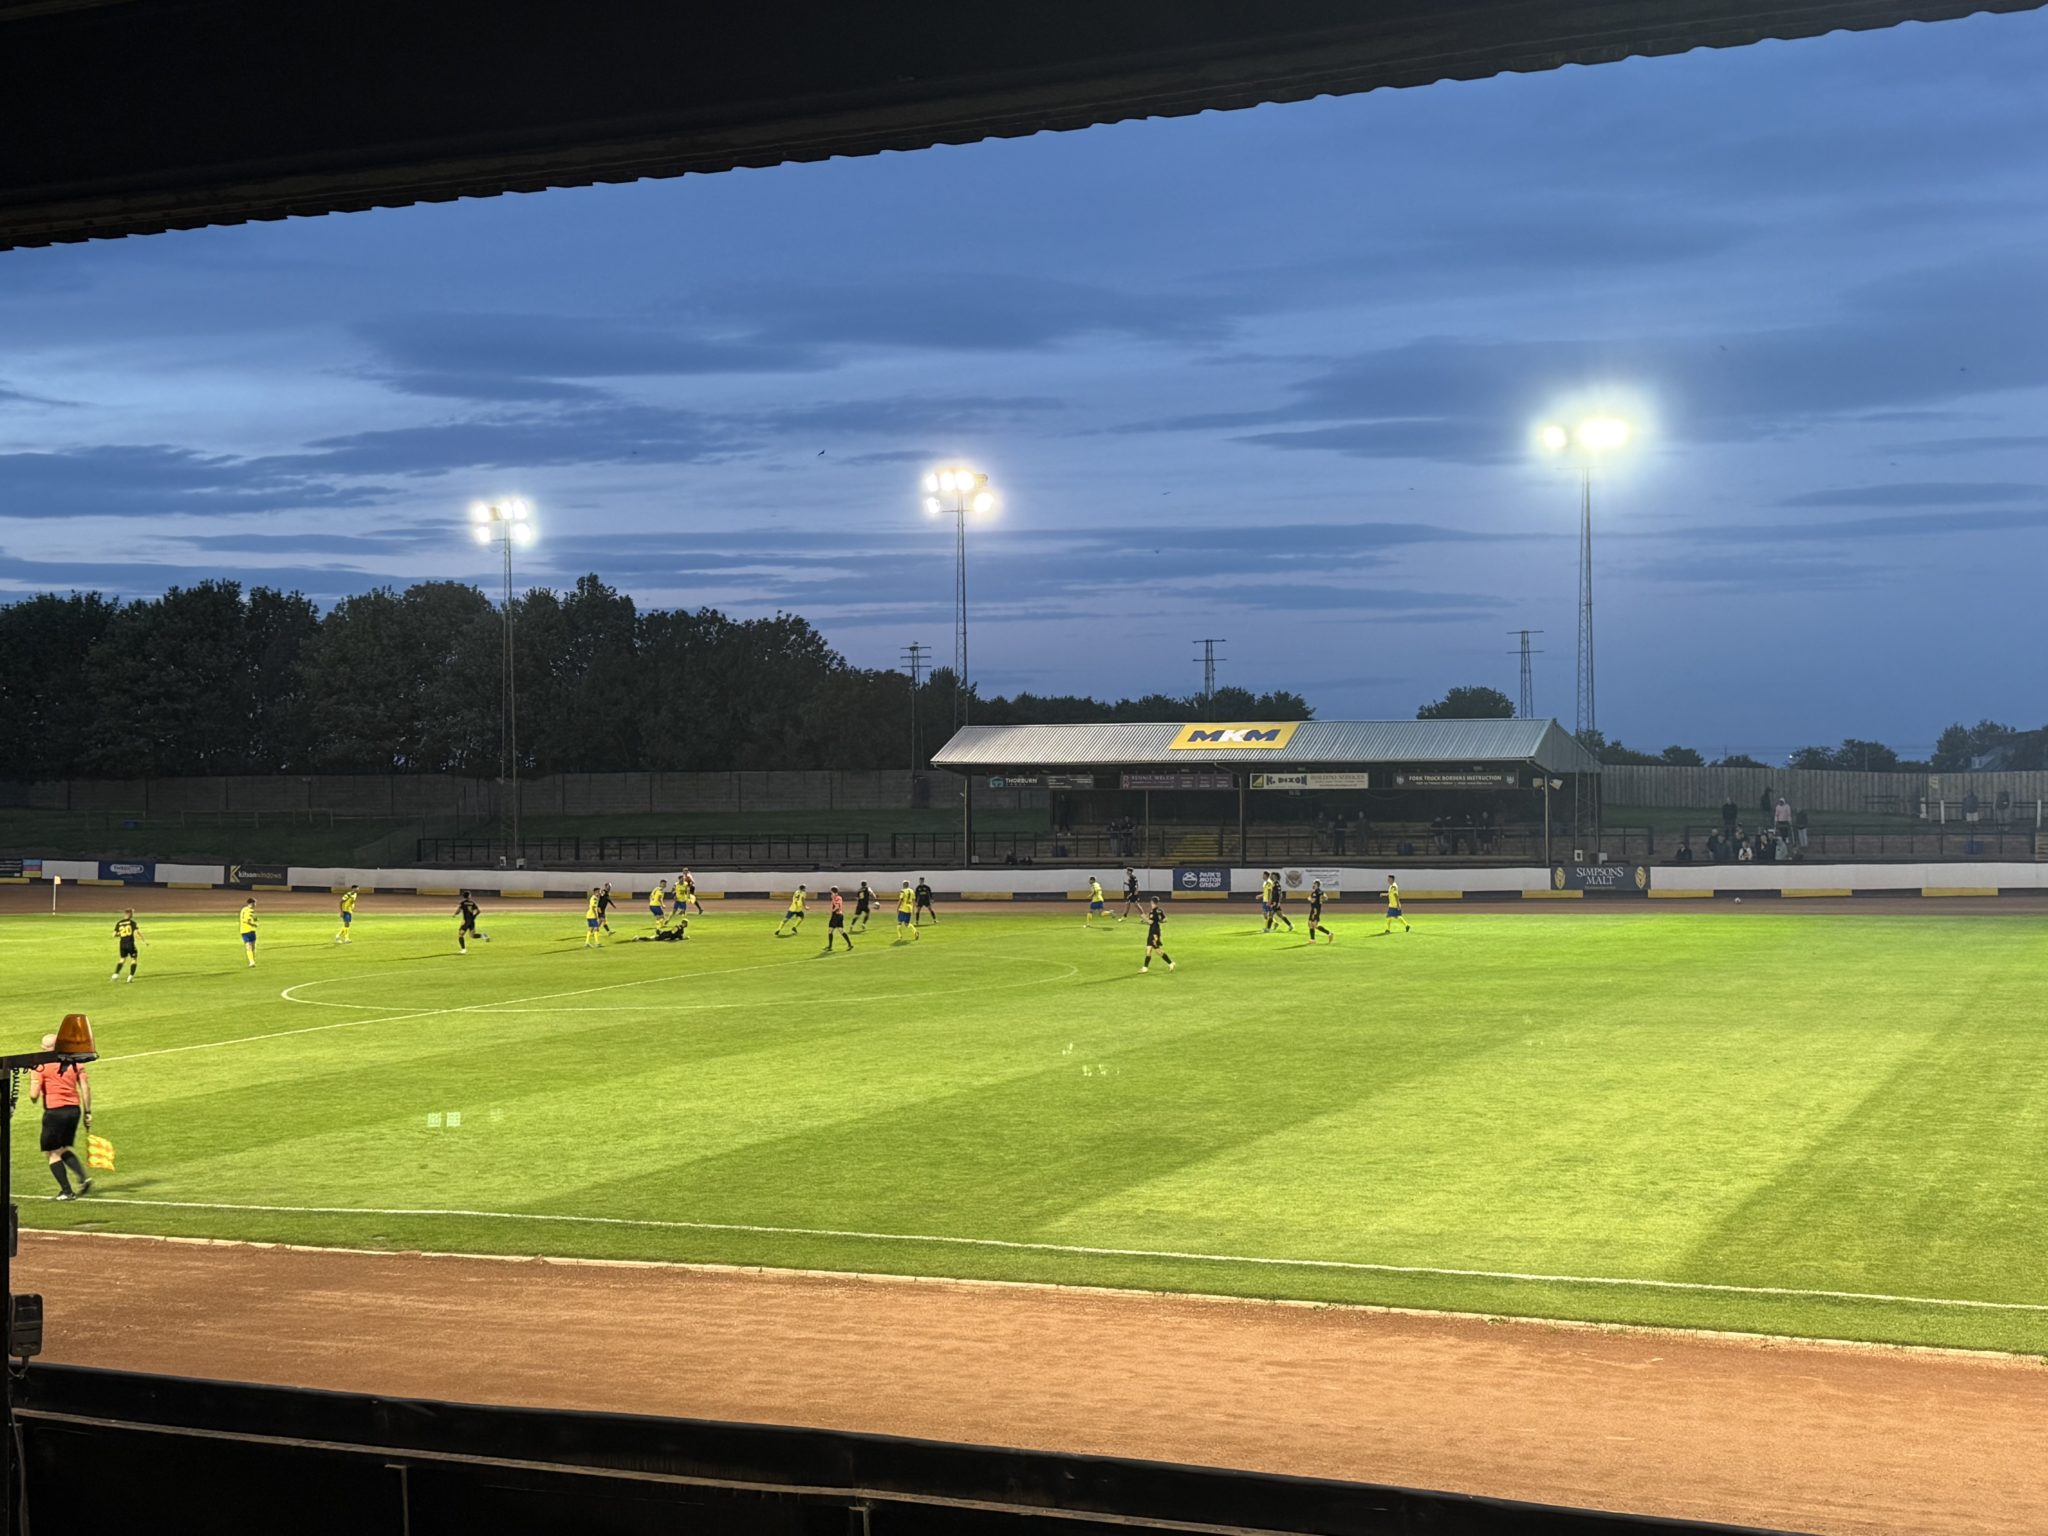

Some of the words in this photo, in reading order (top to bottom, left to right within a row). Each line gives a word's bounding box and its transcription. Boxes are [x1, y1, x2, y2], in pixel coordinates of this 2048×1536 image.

[1187, 729, 1281, 742] MKM
[1278, 775, 1308, 785] DIXON
[1576, 866, 1624, 878] SIMPSONS
[1586, 876, 1614, 885] MALT
[119, 925, 132, 937] 20
